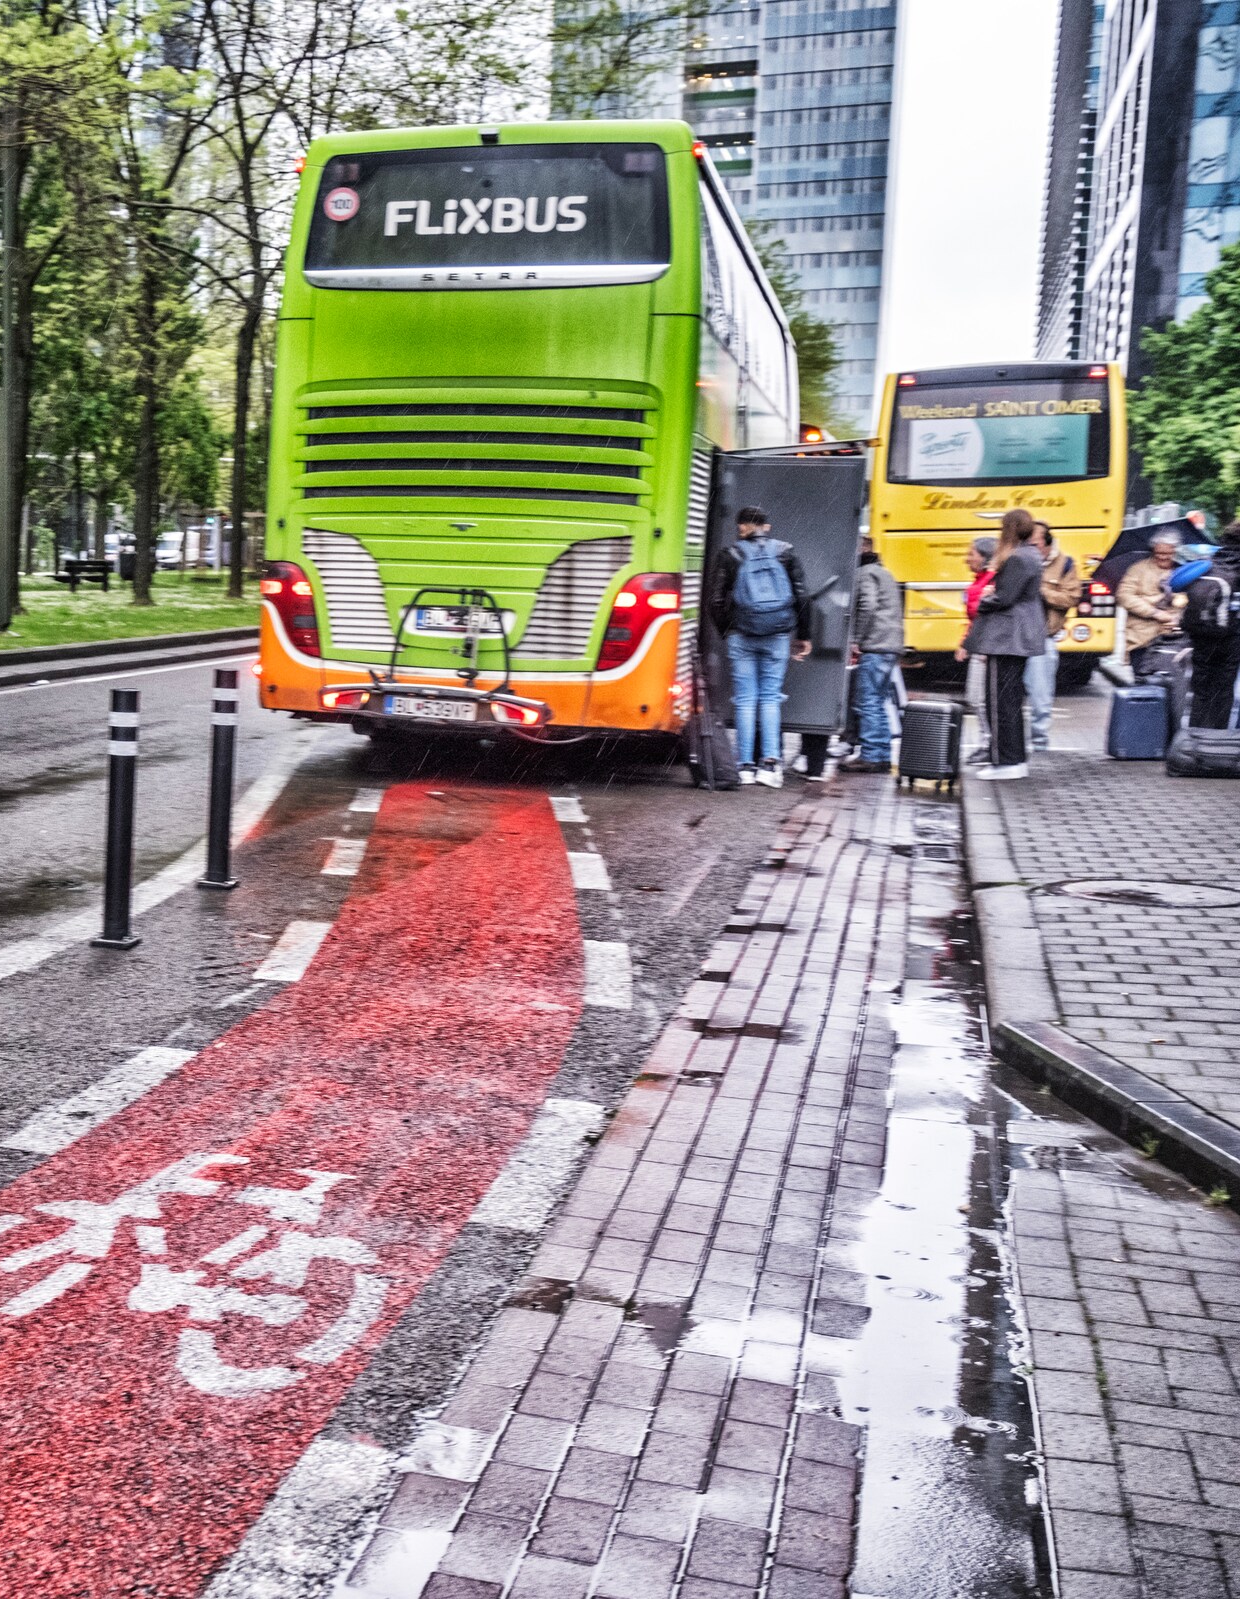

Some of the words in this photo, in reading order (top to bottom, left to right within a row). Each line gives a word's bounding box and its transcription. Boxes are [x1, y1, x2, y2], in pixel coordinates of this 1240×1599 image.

[421, 271, 539, 282] SETRA
[898, 403, 978, 419] Weekend
[983, 400, 1041, 417] SAINT
[1041, 398, 1103, 415] OMER
[920, 491, 1011, 510] Linden
[1009, 489, 1066, 508] Cars
